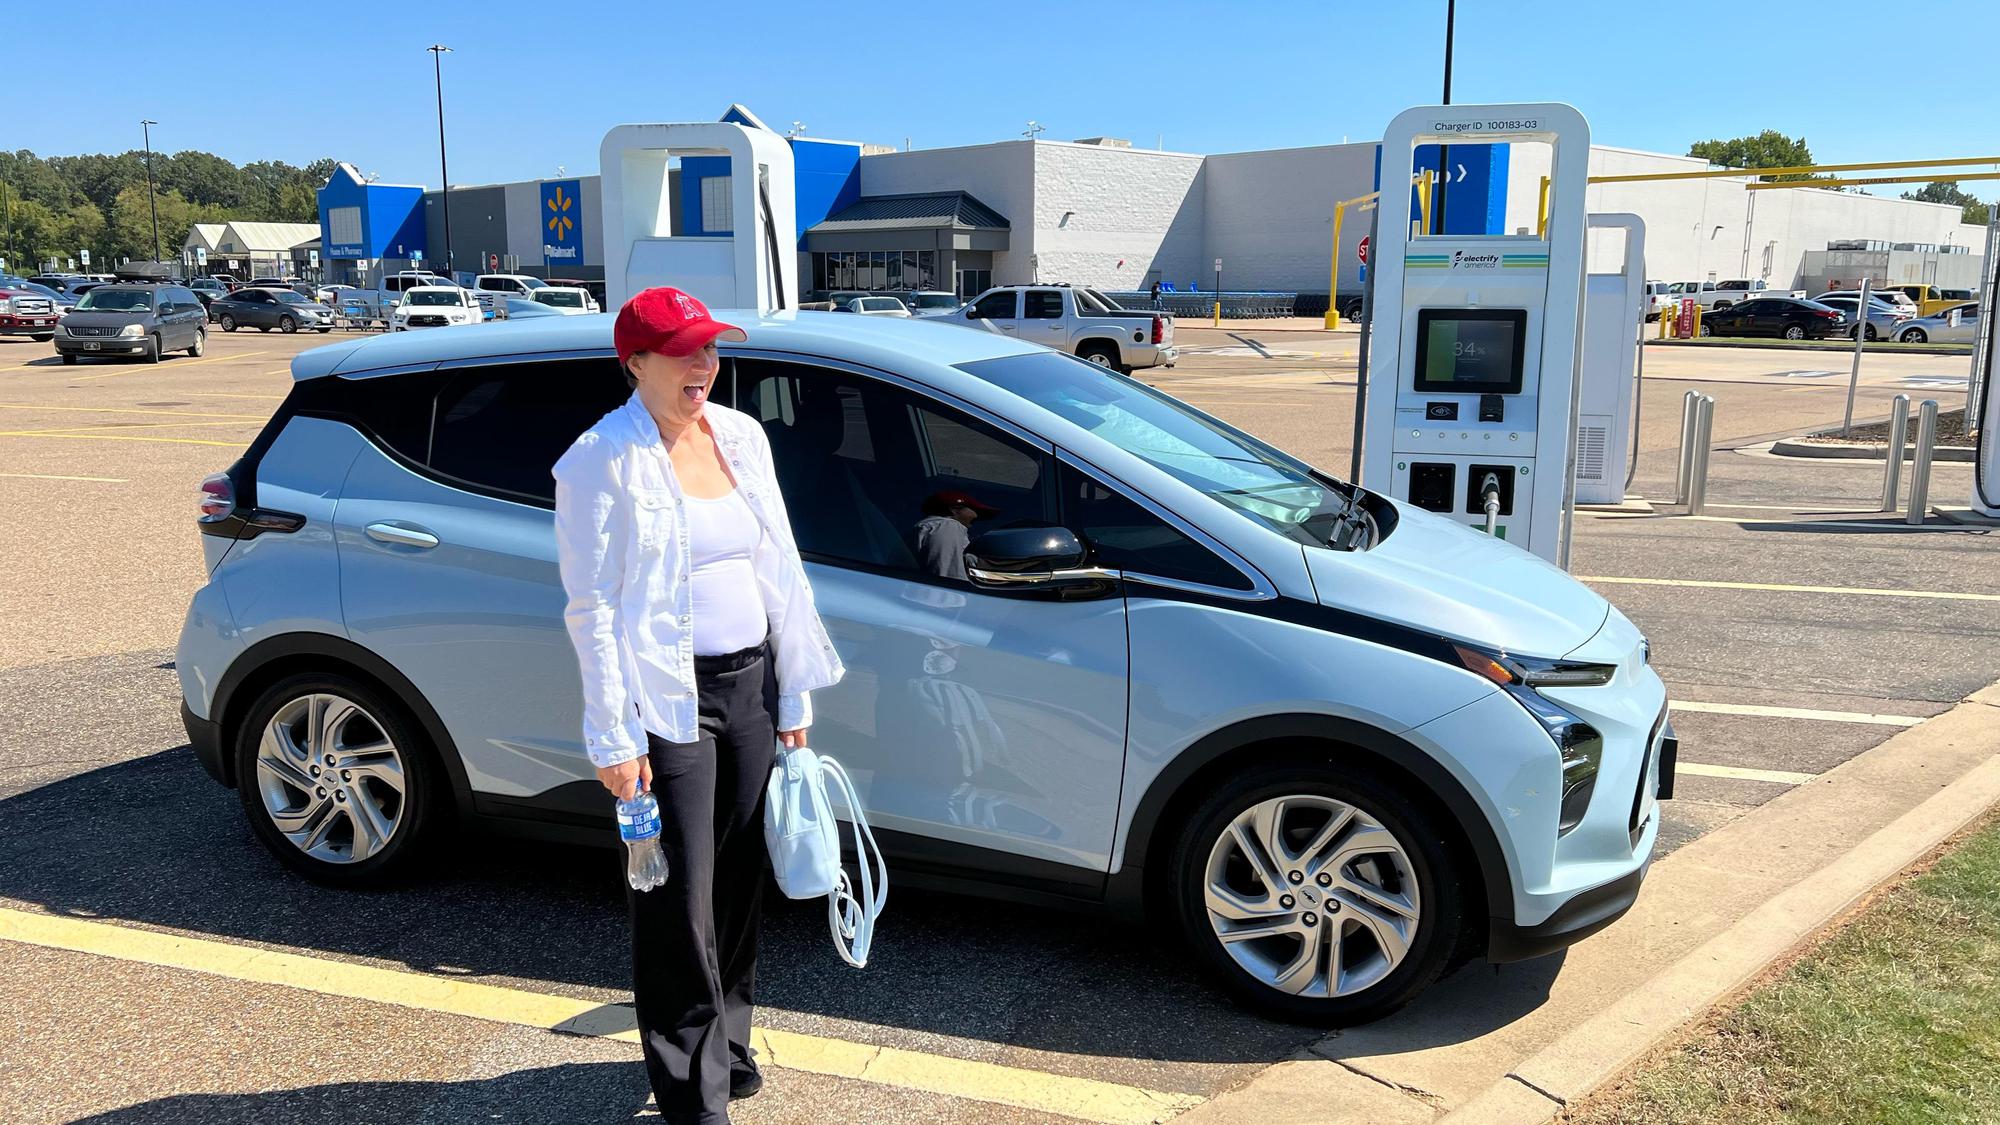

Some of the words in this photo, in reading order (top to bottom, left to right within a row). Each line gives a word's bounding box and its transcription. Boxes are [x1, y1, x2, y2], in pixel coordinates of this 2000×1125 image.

[1434, 122, 1471, 132] Charger
[1473, 122, 1483, 130] ID
[1488, 120, 1538, 130] 100183-03
[1464, 255, 1499, 263] electrify
[675, 293, 704, 320] A
[634, 812, 651, 825] DEJA
[636, 821, 653, 835] BLUE
